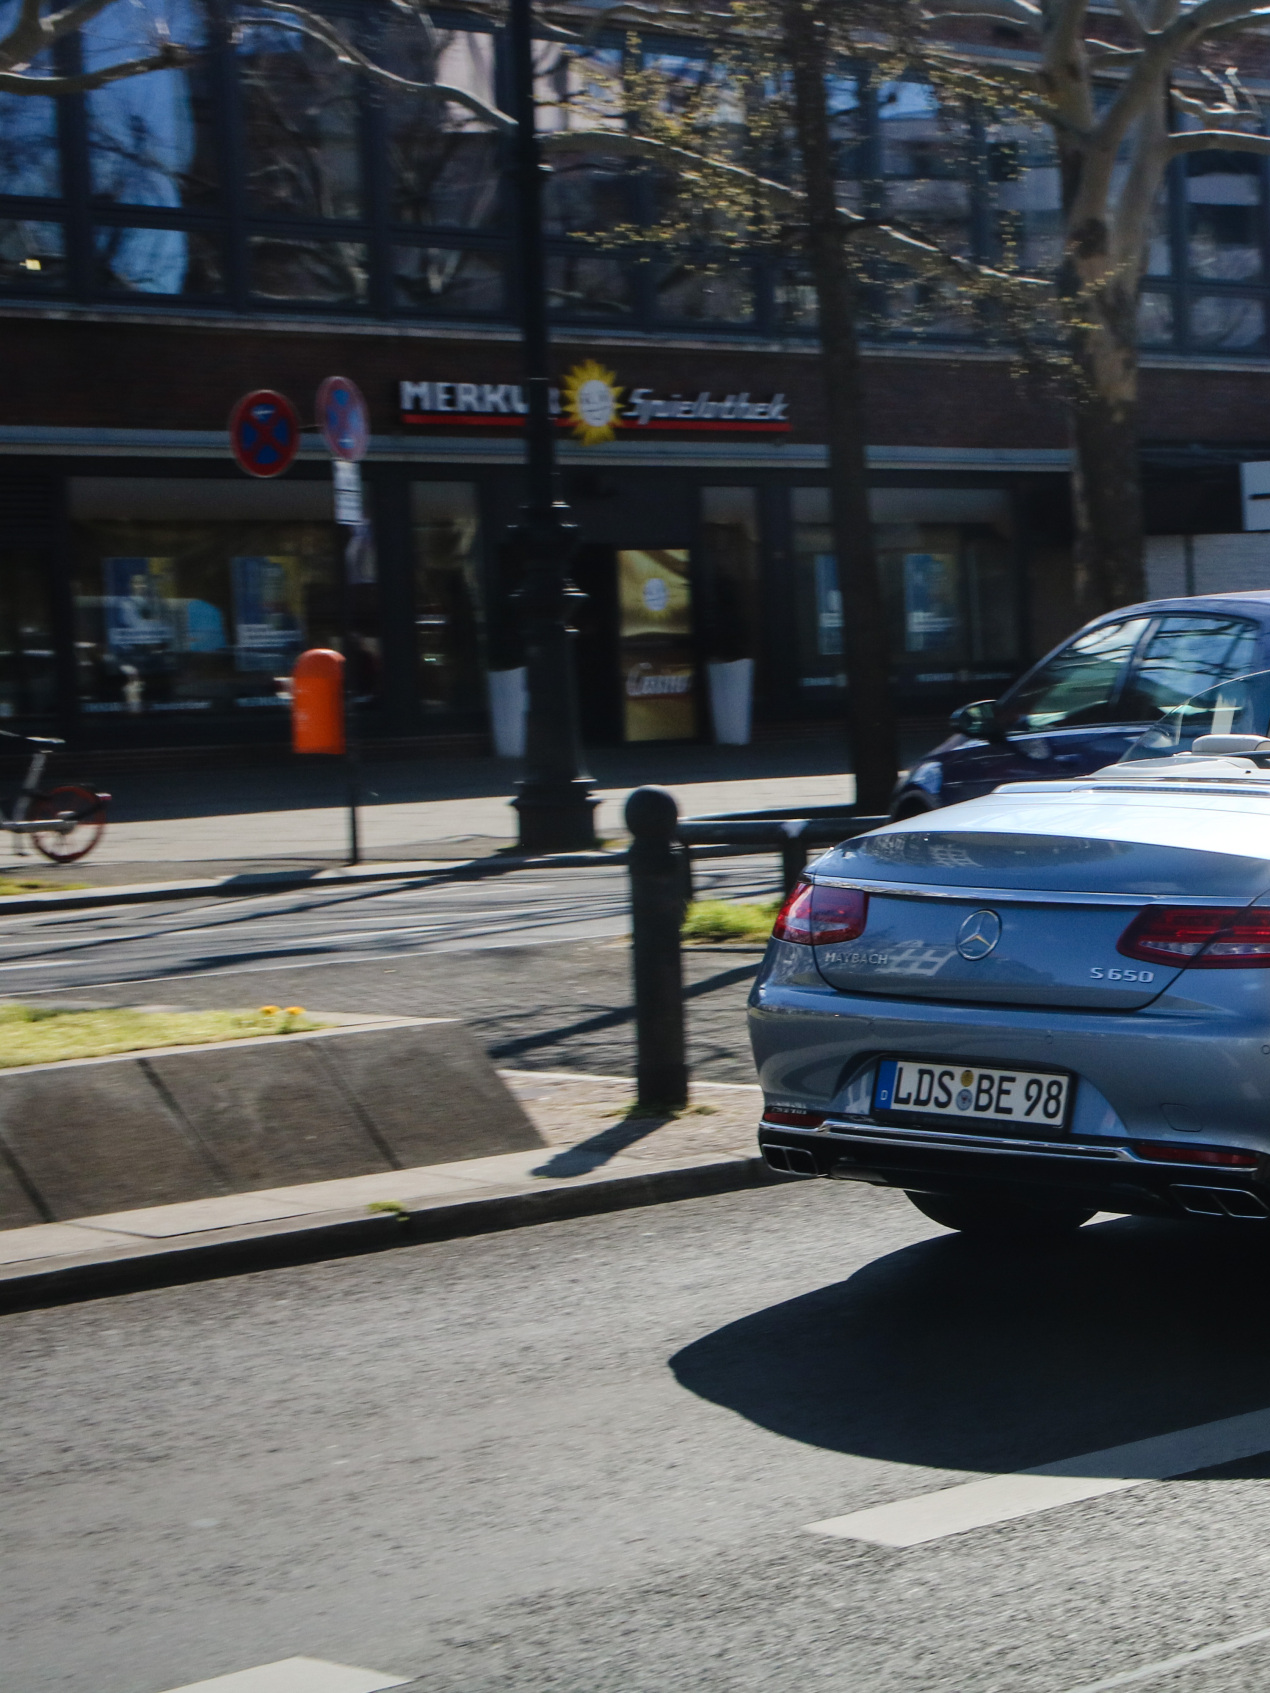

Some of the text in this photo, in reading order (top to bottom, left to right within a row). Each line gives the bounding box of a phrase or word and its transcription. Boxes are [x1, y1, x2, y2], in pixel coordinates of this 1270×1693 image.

[824, 952, 888, 965] MAYBACH
[1107, 968, 1154, 983] 650
[894, 1066, 955, 1109] LDS
[974, 1073, 1016, 1115] BE
[1024, 1078, 1064, 1119] 98
